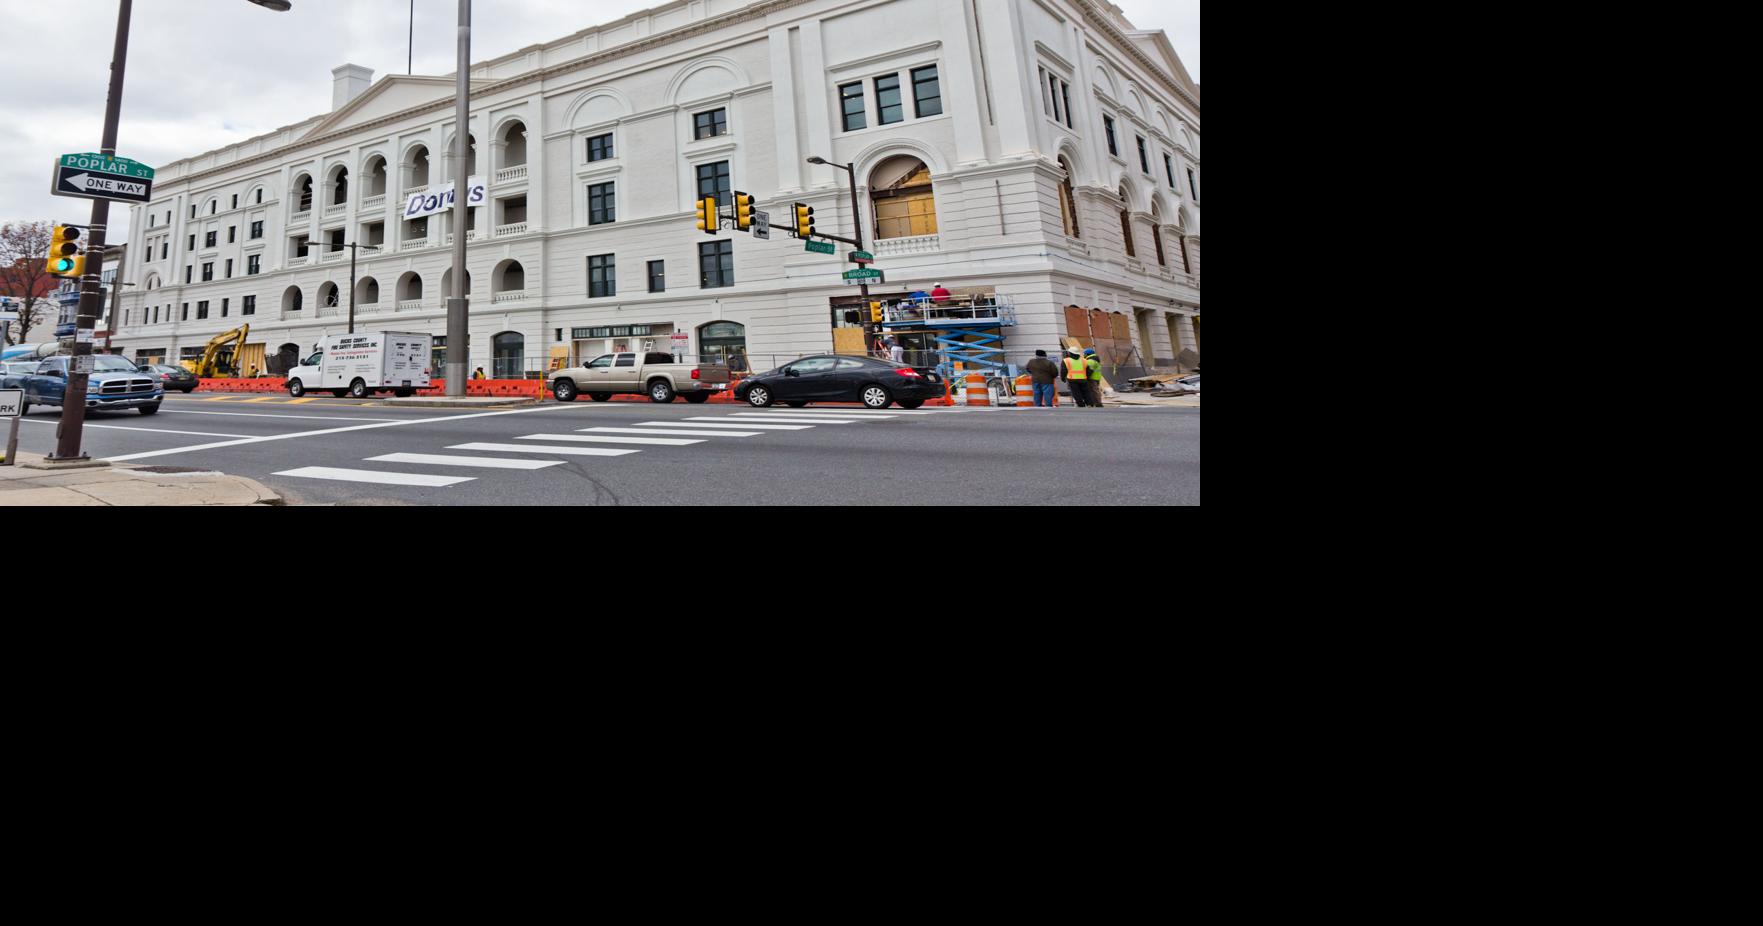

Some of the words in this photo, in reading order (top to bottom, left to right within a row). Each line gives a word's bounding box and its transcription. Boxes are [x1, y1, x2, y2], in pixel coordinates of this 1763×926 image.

[67, 156, 128, 174] POPLAR
[136, 169, 148, 177] ST
[86, 178, 112, 190] ONE
[117, 182, 143, 193] WAY
[756, 213, 767, 221] ONE
